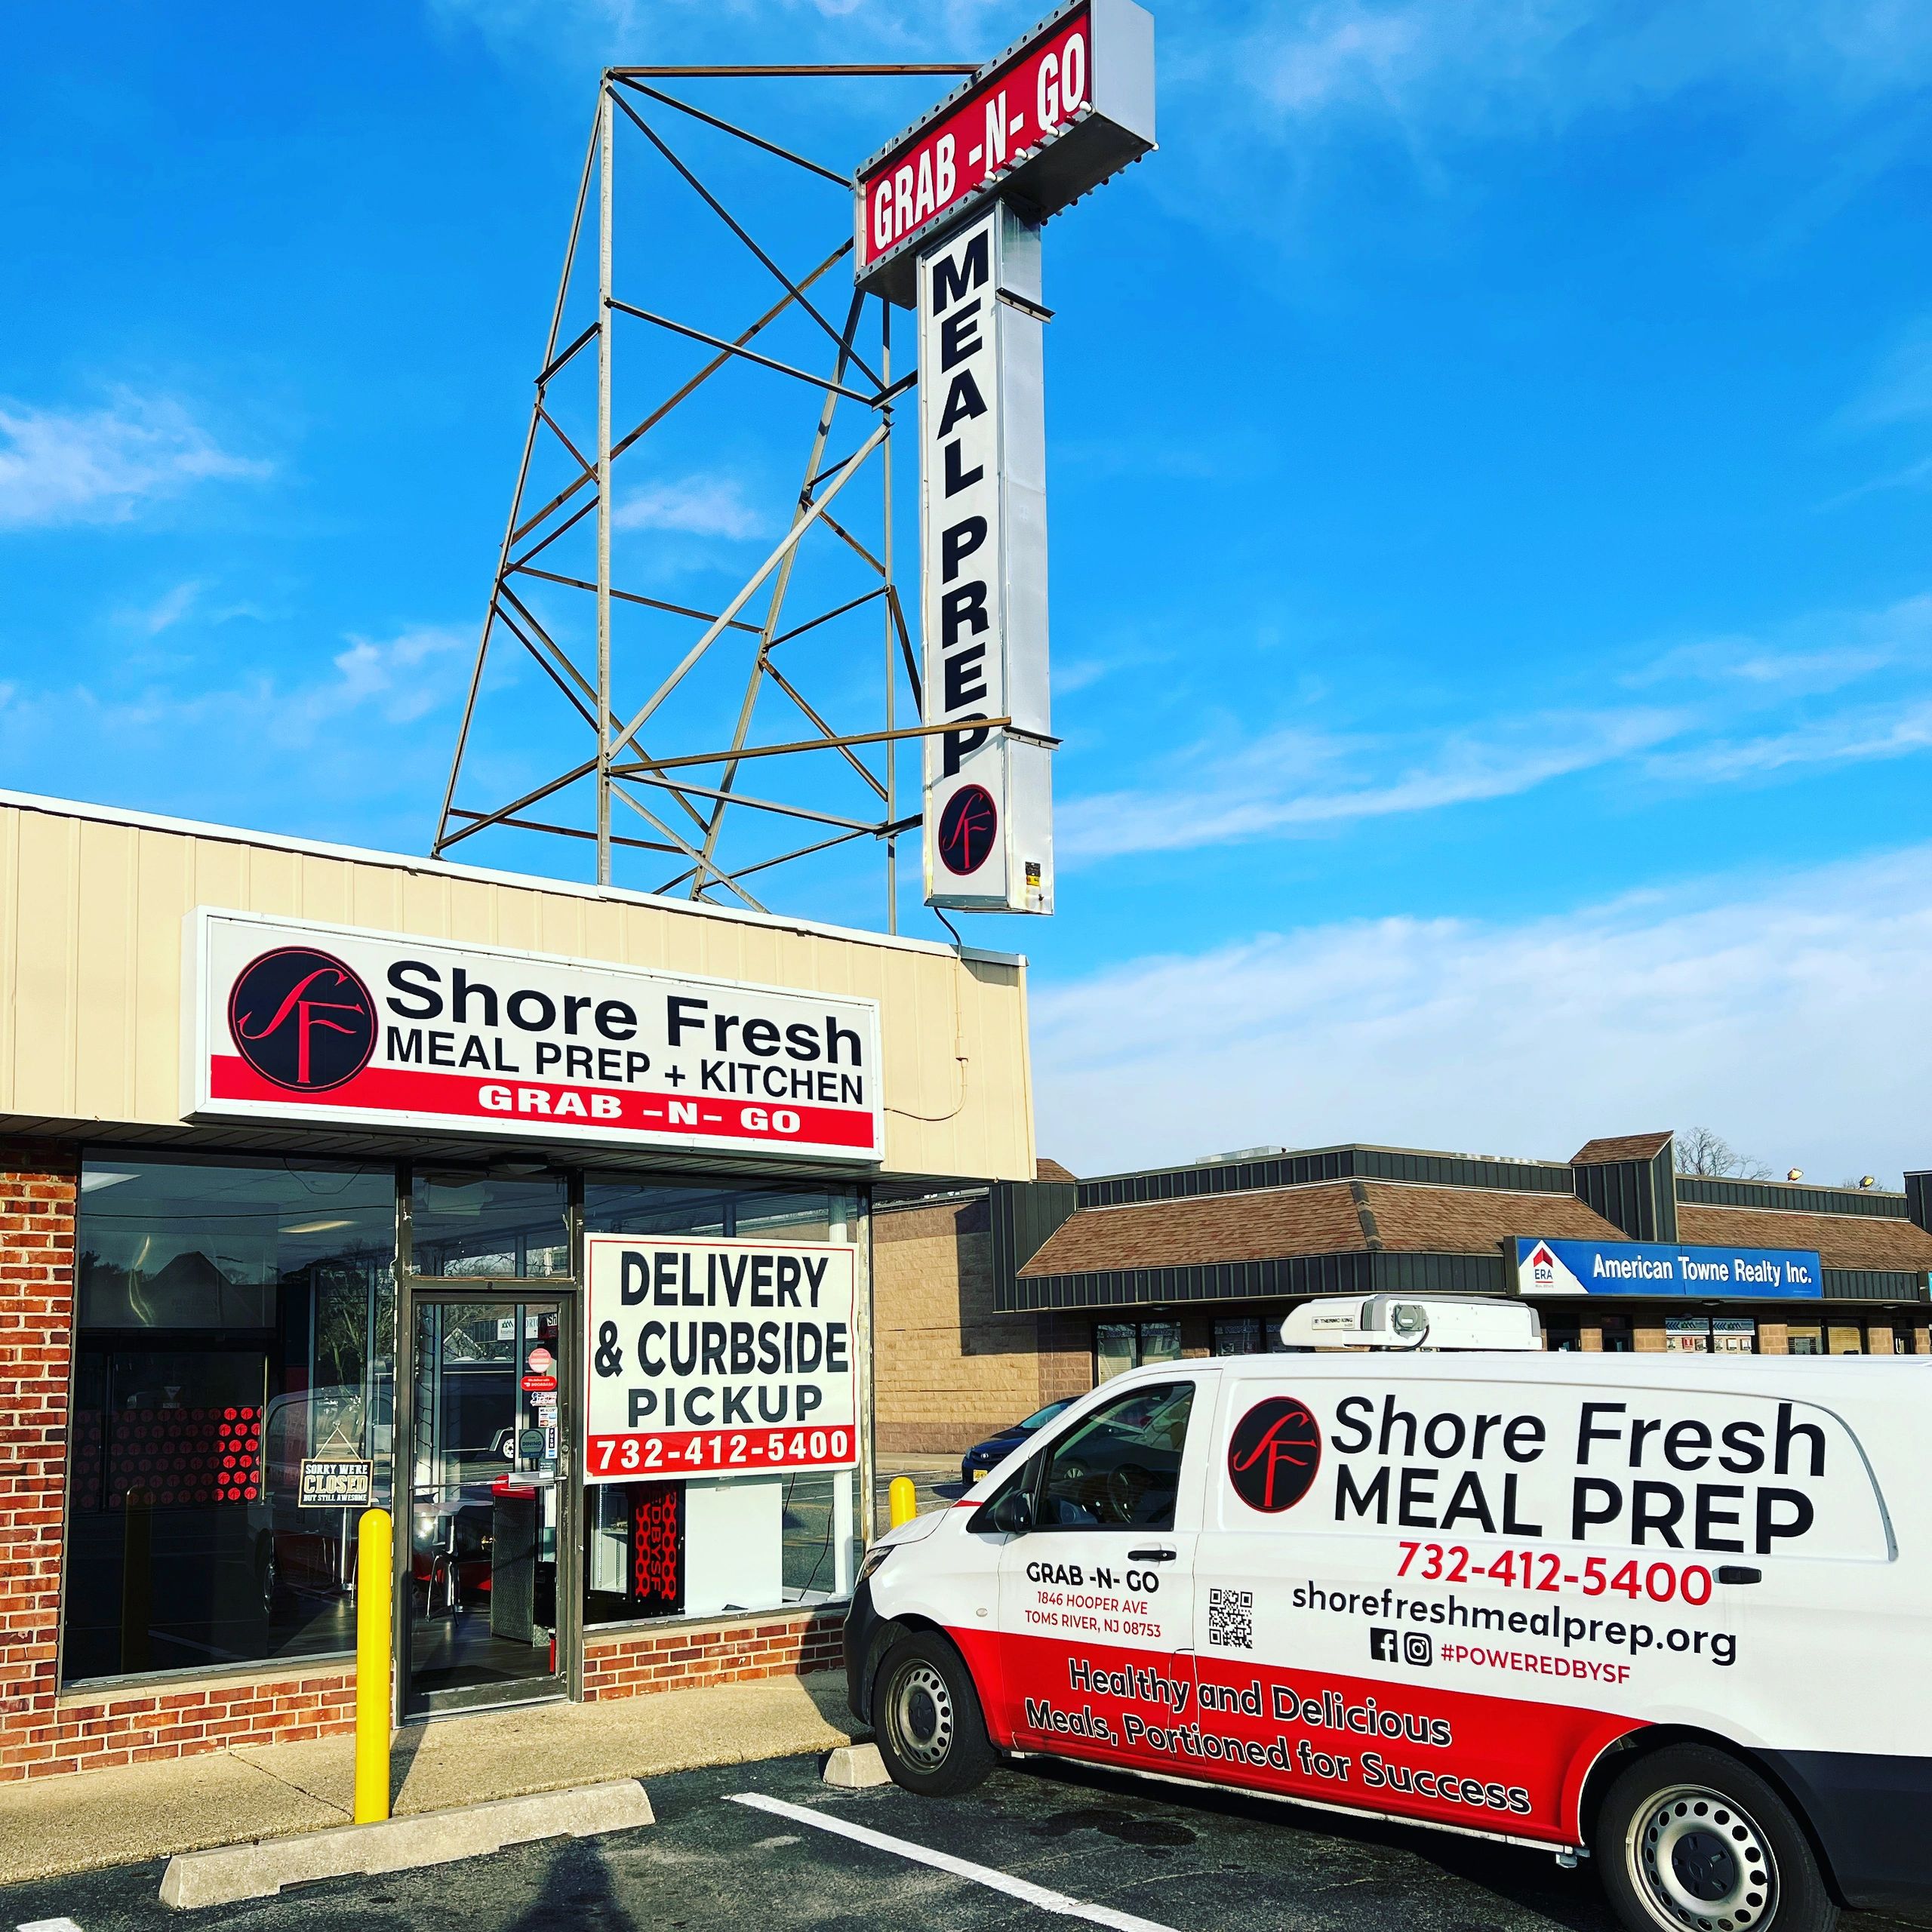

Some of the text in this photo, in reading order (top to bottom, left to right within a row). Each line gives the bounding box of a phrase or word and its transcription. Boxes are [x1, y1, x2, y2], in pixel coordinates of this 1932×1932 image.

[874, 133, 956, 250] GRAB
[1036, 32, 1085, 131] GO
[933, 228, 990, 779] MEAL PREP
[386, 960, 862, 1067] Shore Fresh
[386, 1026, 863, 1104] MEAL PREP + KITCHEN
[478, 1085, 623, 1118] GRAB
[740, 1108, 801, 1133] GO
[620, 1251, 829, 1308] DELIVERY
[1534, 1269, 1553, 1279] ERA
[1593, 1254, 1811, 1287] American Towne Realty Inc.
[595, 1320, 848, 1377] & CURBSIDE
[629, 1384, 822, 1428] PICKUP
[596, 1429, 848, 1470] 732-412-5400
[1331, 1394, 1826, 1477] Shore Fresh
[303, 1475, 368, 1494] CLOSED
[306, 1464, 337, 1475] SORRY
[1335, 1463, 1814, 1555] MEAL PREP
[1026, 1561, 1084, 1586] GRAB
[1127, 1571, 1159, 1593] GO
[1397, 1542, 1712, 1606] 732-412-5400
[1025, 1611, 1161, 1638] TOMS RIVER, NJ 08753
[1038, 1591, 1148, 1615] 1846 HOOPER AVE
[1293, 1580, 1737, 1666] shorefreshmealprep.org
[1441, 1644, 1630, 1684] #POWEREDBYSF
[1069, 1658, 1453, 1747] Healthy and Delicious
[1025, 1697, 1532, 1815] Meals, Portioned for Success
